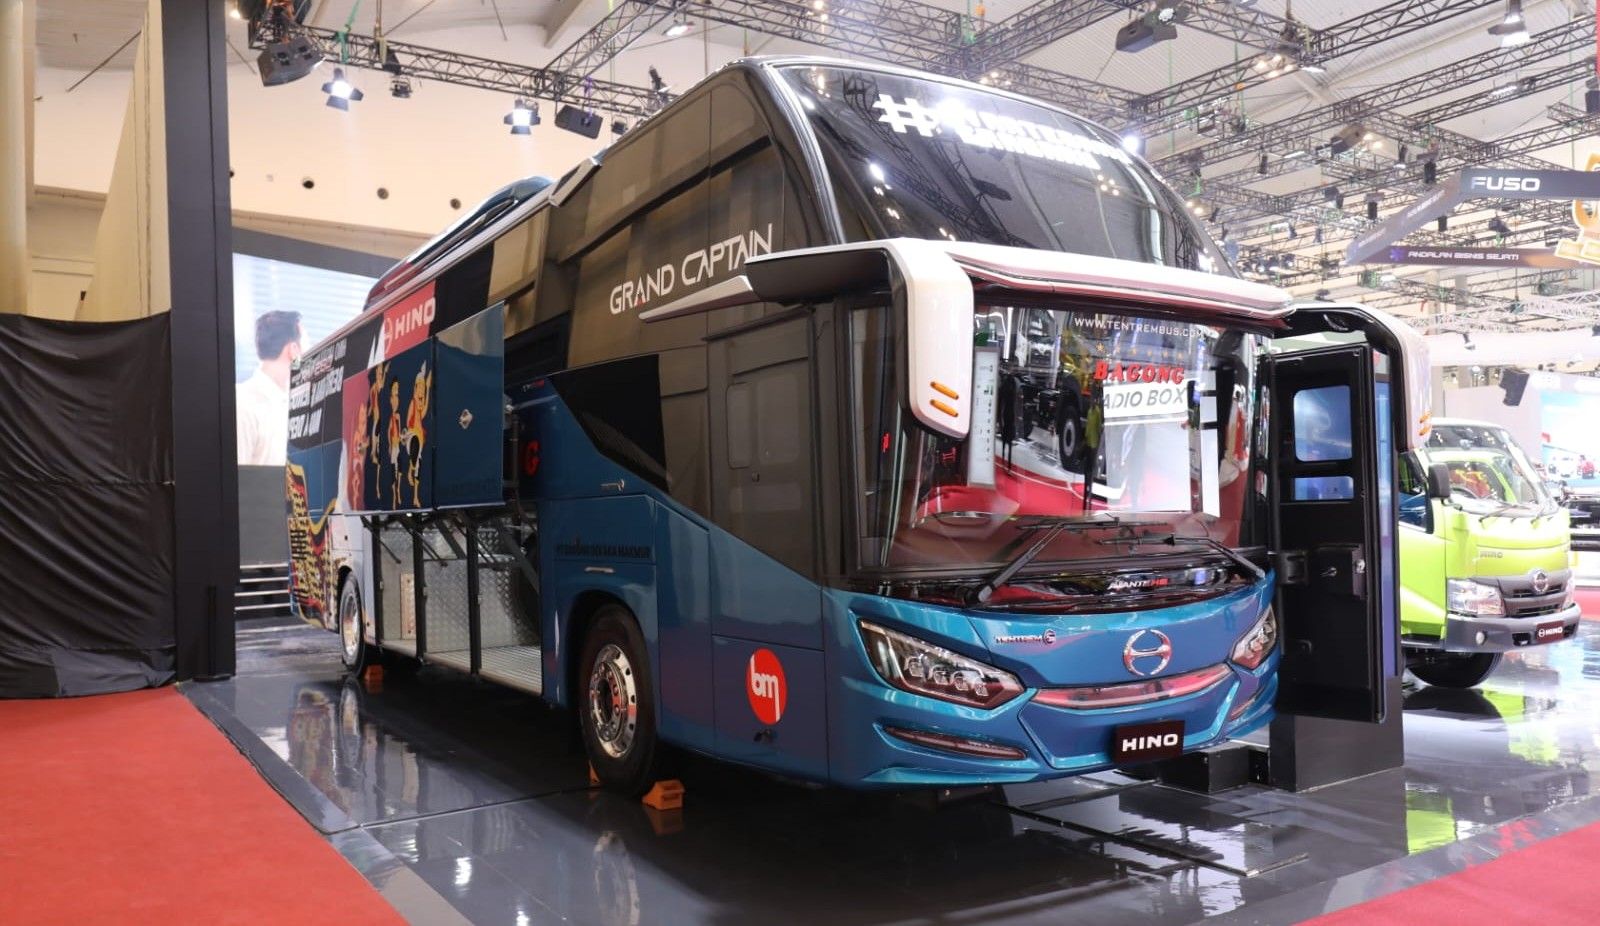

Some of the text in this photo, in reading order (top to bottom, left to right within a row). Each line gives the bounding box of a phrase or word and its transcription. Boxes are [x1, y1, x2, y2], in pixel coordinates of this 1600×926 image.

[1471, 176, 1541, 192] FUSO
[1408, 251, 1453, 259] ANDALAN
[1486, 253, 1520, 261] SEJATI
[609, 222, 773, 315] GRAND CAPTAIN
[394, 296, 436, 341] HINO
[1094, 360, 1185, 385] BAGONG
[1146, 387, 1188, 406] BOX
[1545, 626, 1563, 635] HINO
[1121, 733, 1179, 753] HINO
